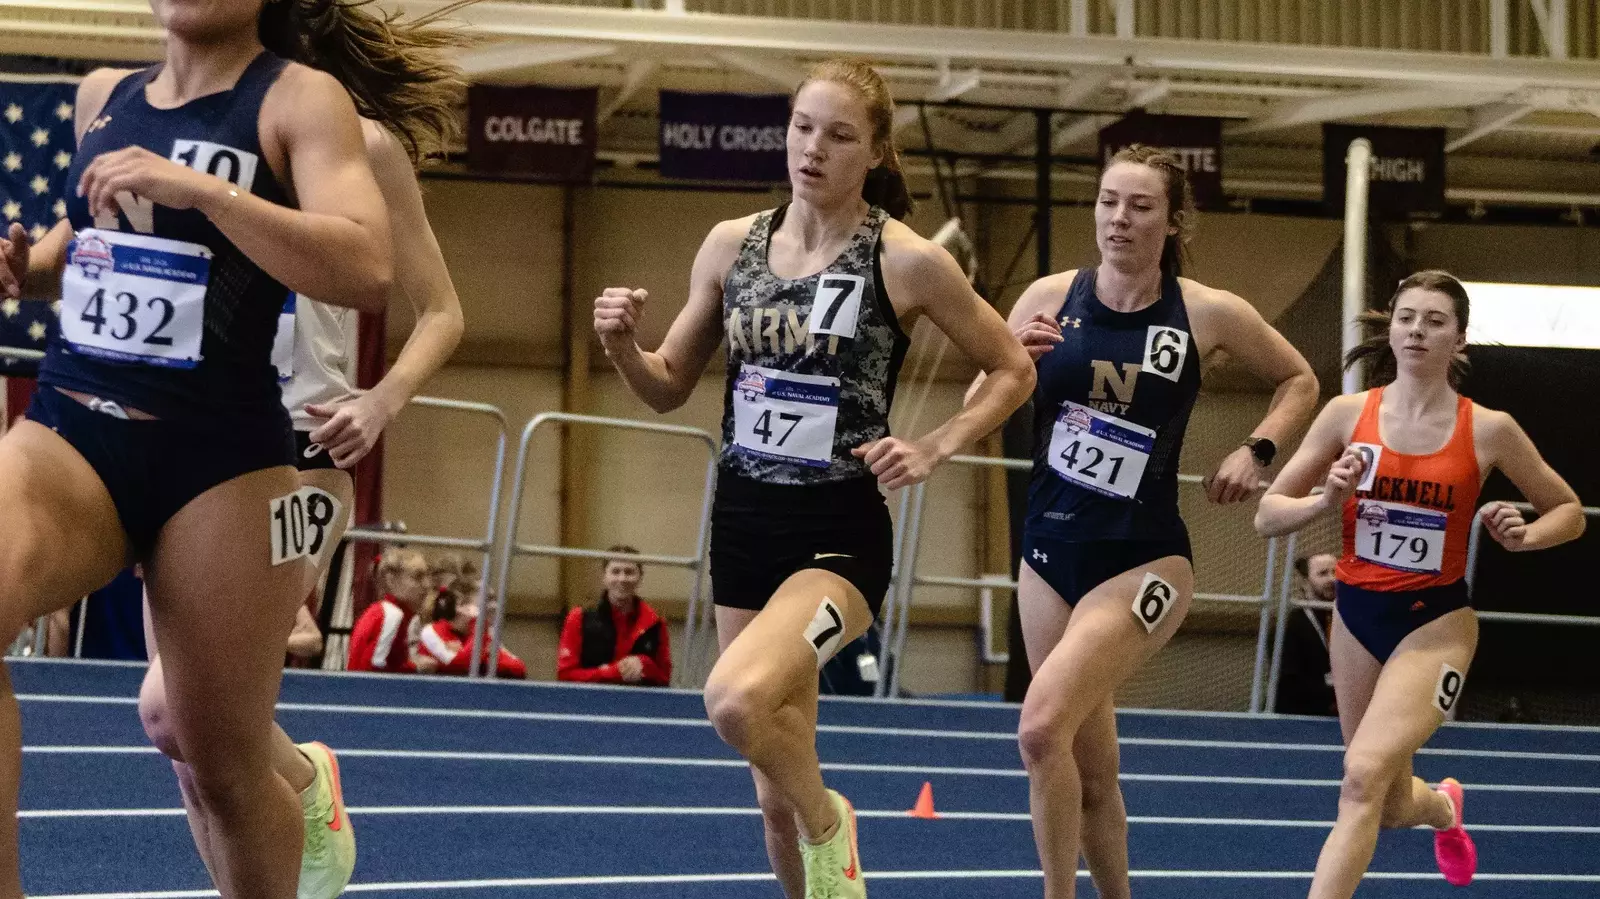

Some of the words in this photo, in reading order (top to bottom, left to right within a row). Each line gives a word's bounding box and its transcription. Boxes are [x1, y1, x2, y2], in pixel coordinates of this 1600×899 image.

[484, 115, 584, 145] COLGATE
[663, 122, 717, 150] HOLY
[719, 125, 788, 151] CROSS
[1369, 156, 1426, 184] HIGH
[80, 287, 175, 346] 432
[820, 279, 857, 331] 7
[1150, 329, 1182, 374] 6
[1088, 359, 1143, 403] N
[753, 409, 804, 447] 47
[1088, 400, 1131, 416] NAVY
[1060, 440, 1125, 485] 421
[1355, 476, 1455, 511] UCKNELL
[274, 495, 305, 559] 10
[1371, 531, 1429, 563] 179
[1140, 580, 1171, 624] 6
[812, 603, 843, 650] 7
[1438, 670, 1461, 711] 9
